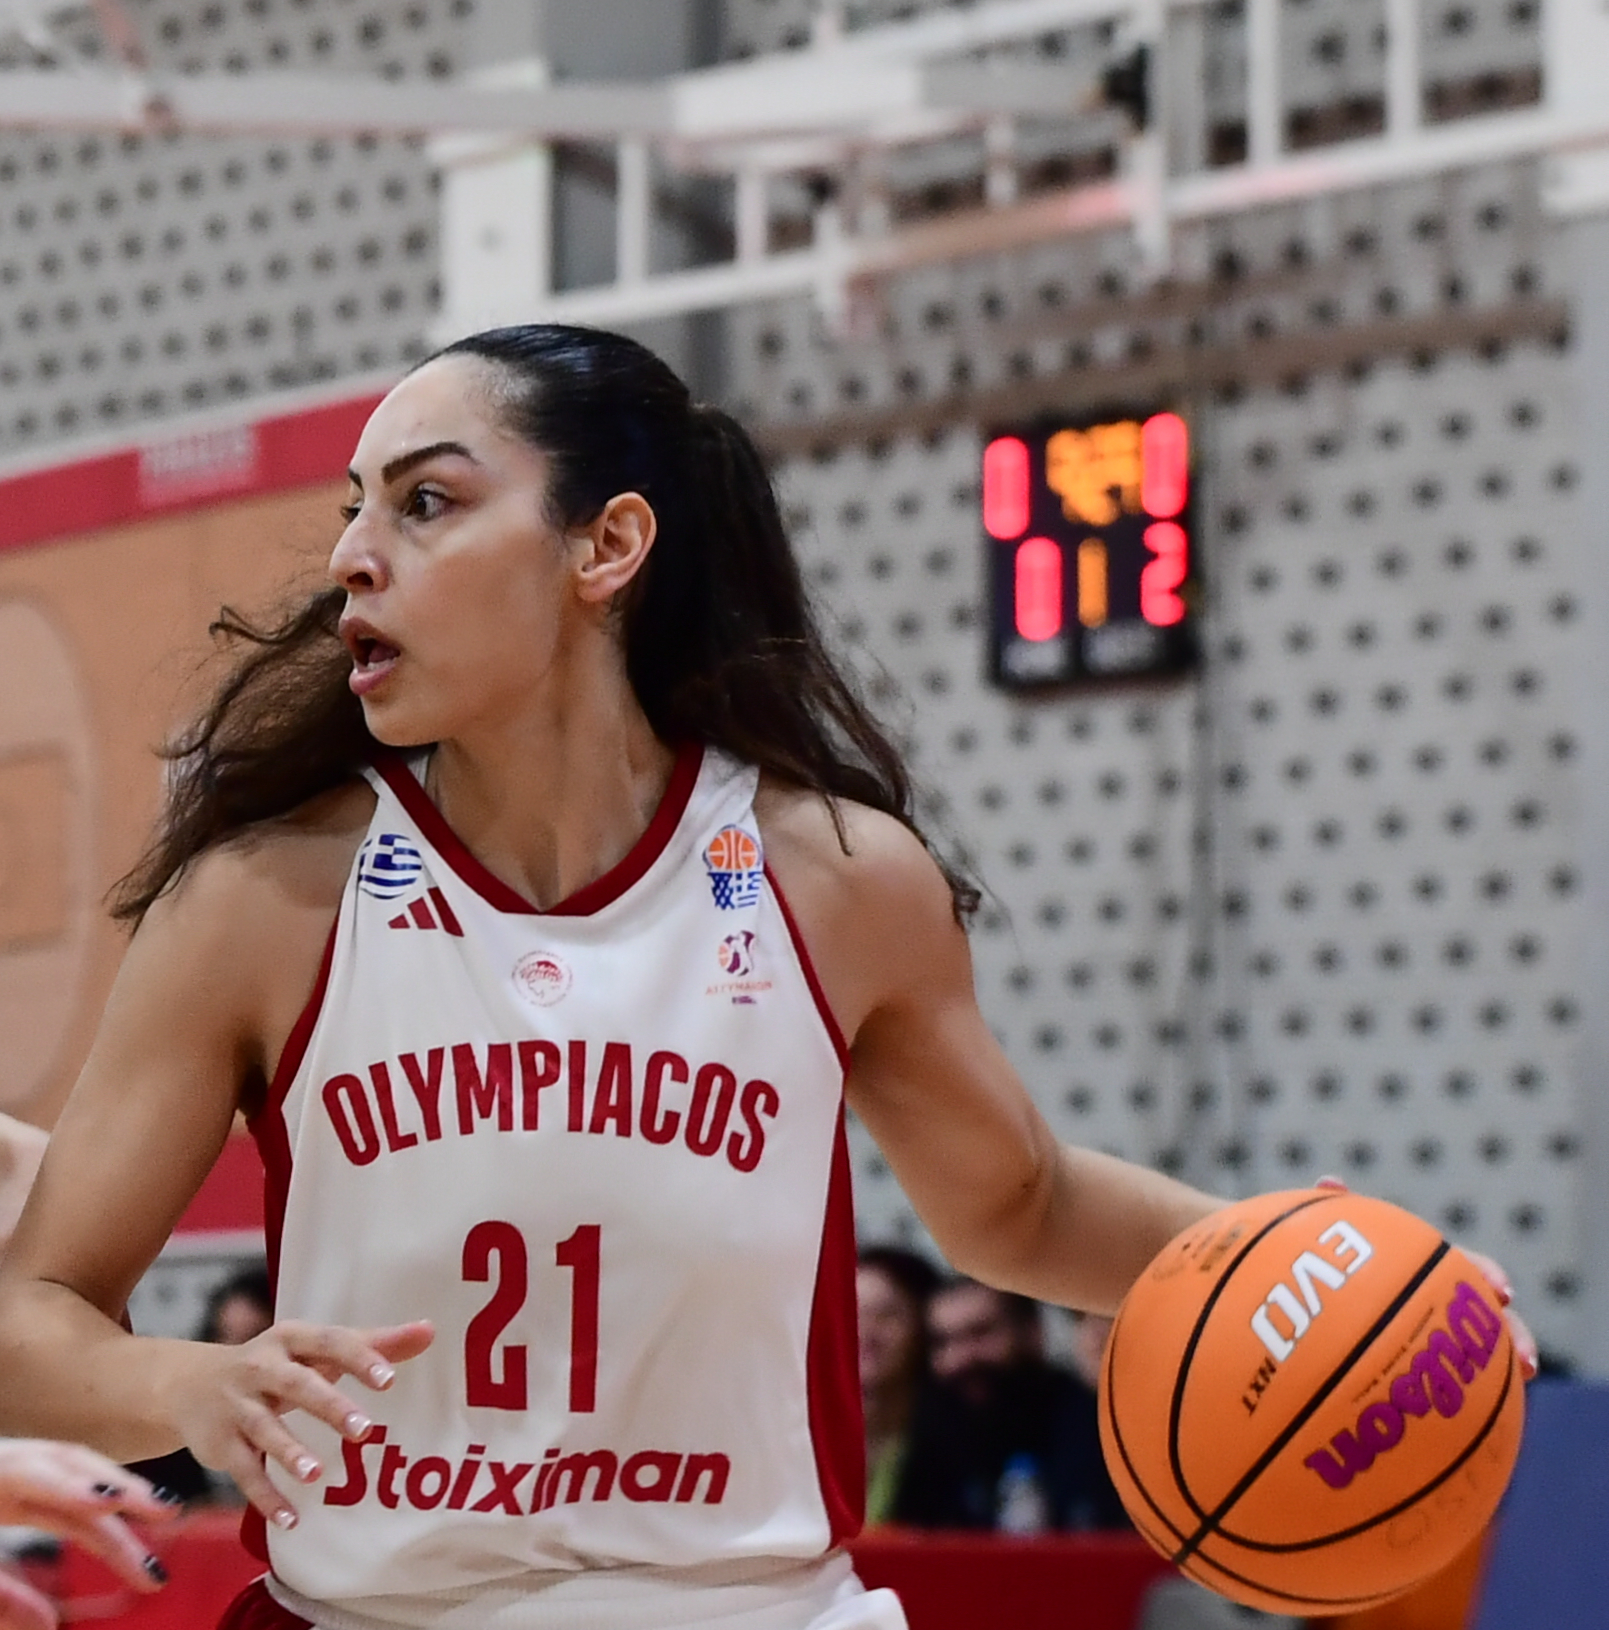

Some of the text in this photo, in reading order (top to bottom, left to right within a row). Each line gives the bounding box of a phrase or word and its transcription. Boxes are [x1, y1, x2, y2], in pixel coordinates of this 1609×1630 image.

[321, 1039, 780, 1173] OLYMPIACOS
[461, 1220, 601, 1414] 21
[1250, 1219, 1374, 1362] EVO
[1241, 1357, 1278, 1417] NXT
[323, 1425, 731, 1516] Stoiximan
